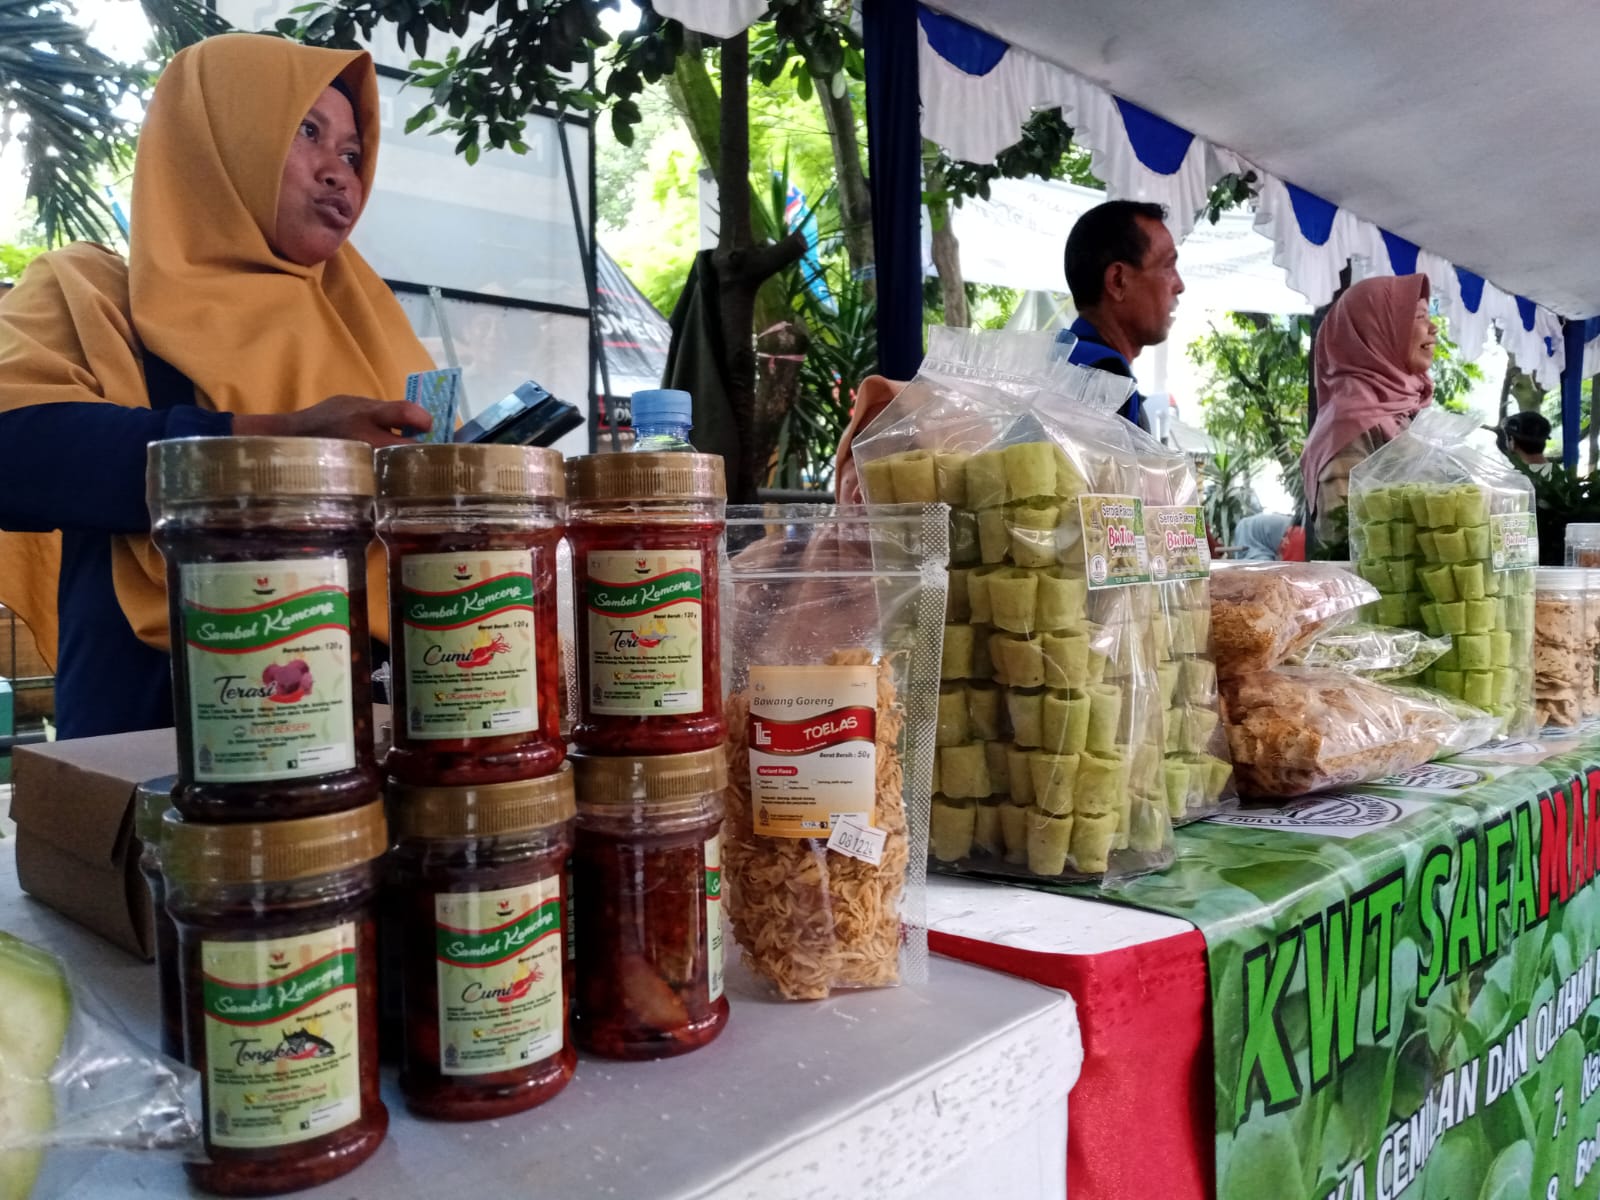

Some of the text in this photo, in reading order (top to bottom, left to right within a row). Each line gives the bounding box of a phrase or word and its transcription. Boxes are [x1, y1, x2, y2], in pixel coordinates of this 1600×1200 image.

[410, 603, 458, 619] Sambal
[594, 593, 637, 607] Sambal
[196, 622, 258, 642] Sambal
[609, 629, 639, 653] Teri
[423, 644, 473, 666] Cumi
[213, 675, 278, 706] Terasi
[753, 696, 834, 708] Bawang Goreng
[803, 716, 859, 742] TOELAS
[446, 941, 499, 958] Sambal
[461, 981, 513, 1004] Cumi
[1233, 868, 1405, 1139] KWT
[214, 996, 273, 1014] Sambal
[1376, 1056, 1480, 1200] CEMILAN
[1484, 1017, 1529, 1107] DAN
[1534, 955, 1593, 1064] OLAHAN
